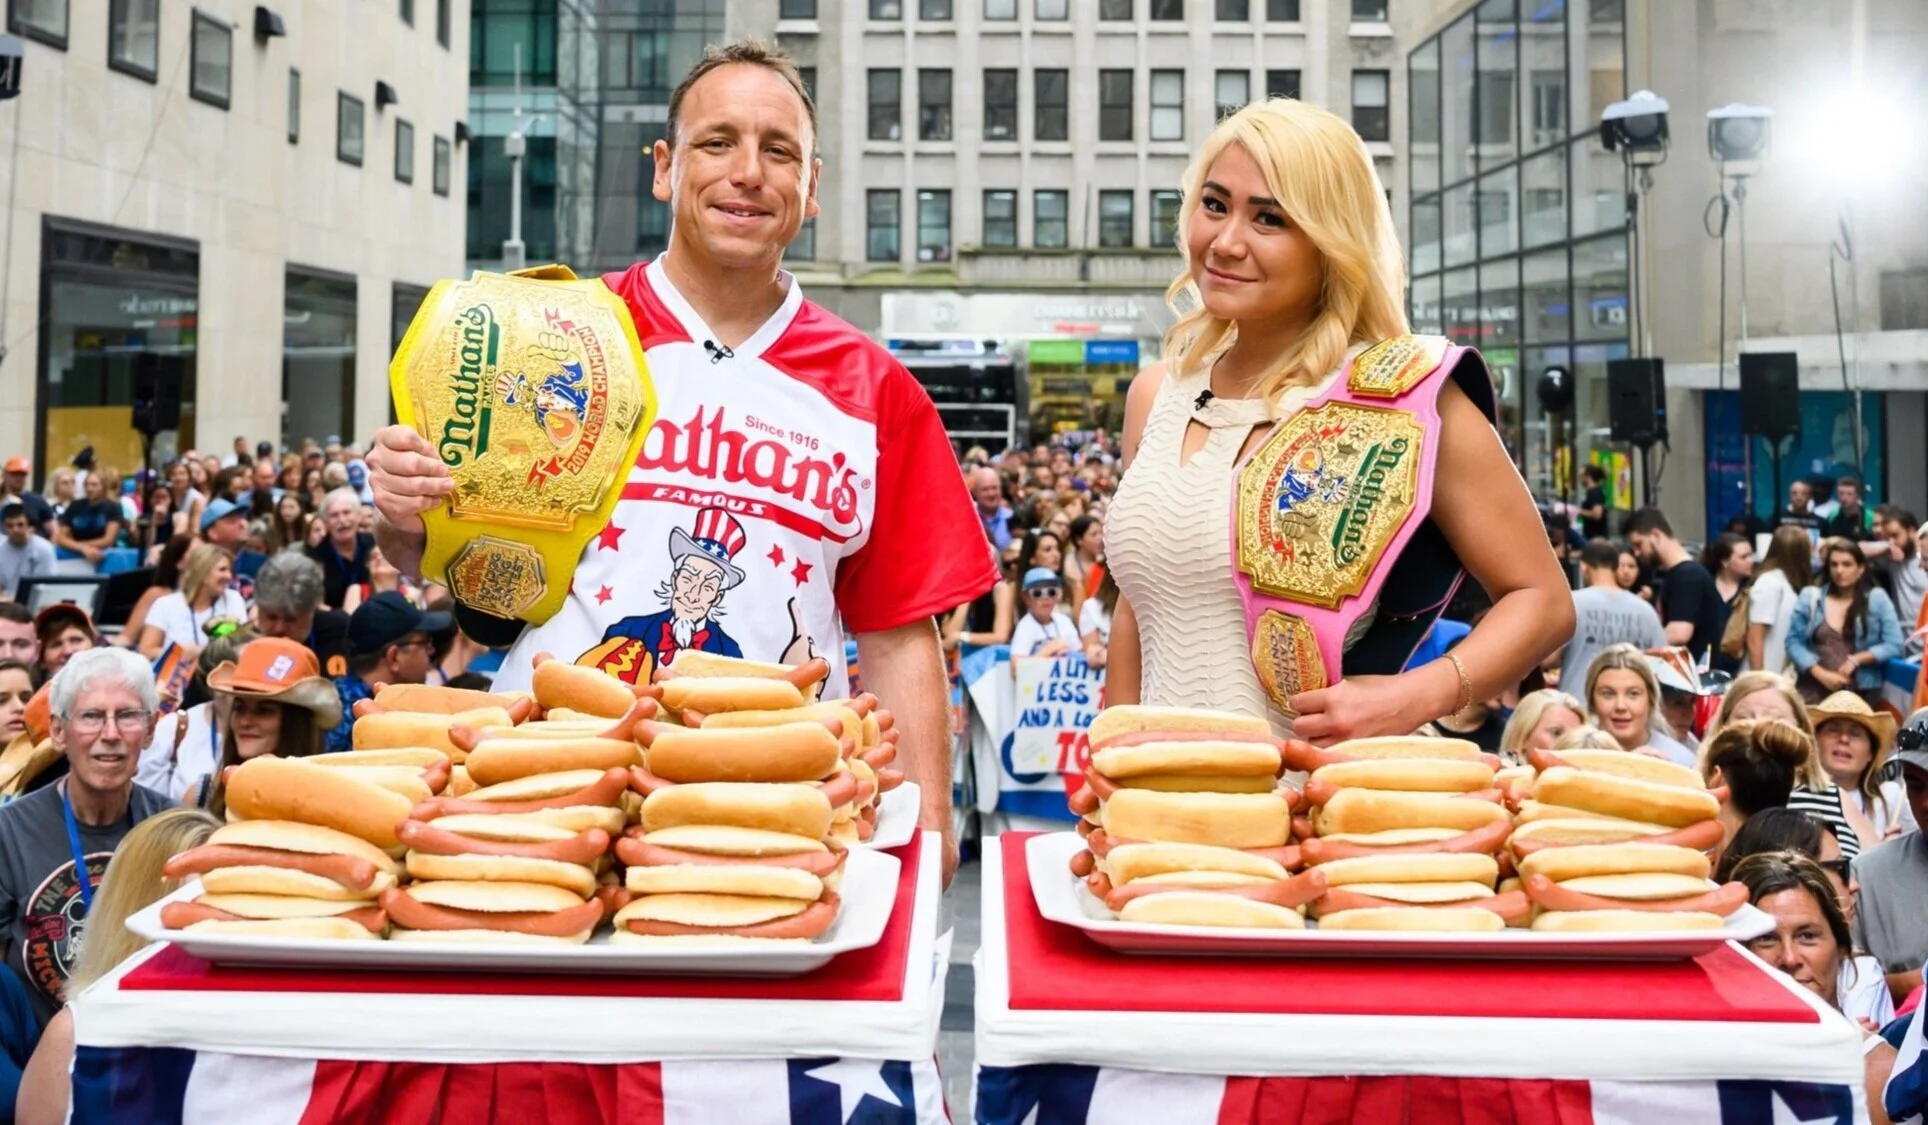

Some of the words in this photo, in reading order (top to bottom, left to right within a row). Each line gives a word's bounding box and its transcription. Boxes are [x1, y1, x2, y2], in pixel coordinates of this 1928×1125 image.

[578, 326, 608, 394] CHAMPION
[439, 306, 487, 466] Nathan's
[584, 396, 606, 445] WORLD
[745, 415, 785, 439] Since
[789, 431, 819, 450] 1916
[567, 445, 591, 474] 2019
[634, 405, 857, 524] athan's
[652, 487, 766, 515] FAMOUS
[1258, 482, 1277, 548] CHAMPION
[1341, 437, 1409, 564] Nathan's
[1287, 628, 1297, 662] HOT
[1050, 660, 1061, 678] A
[1037, 682, 1089, 705] LESS
[1018, 707, 1051, 728] AND
[1054, 707, 1064, 728] A
[36, 878, 68, 912] THE
